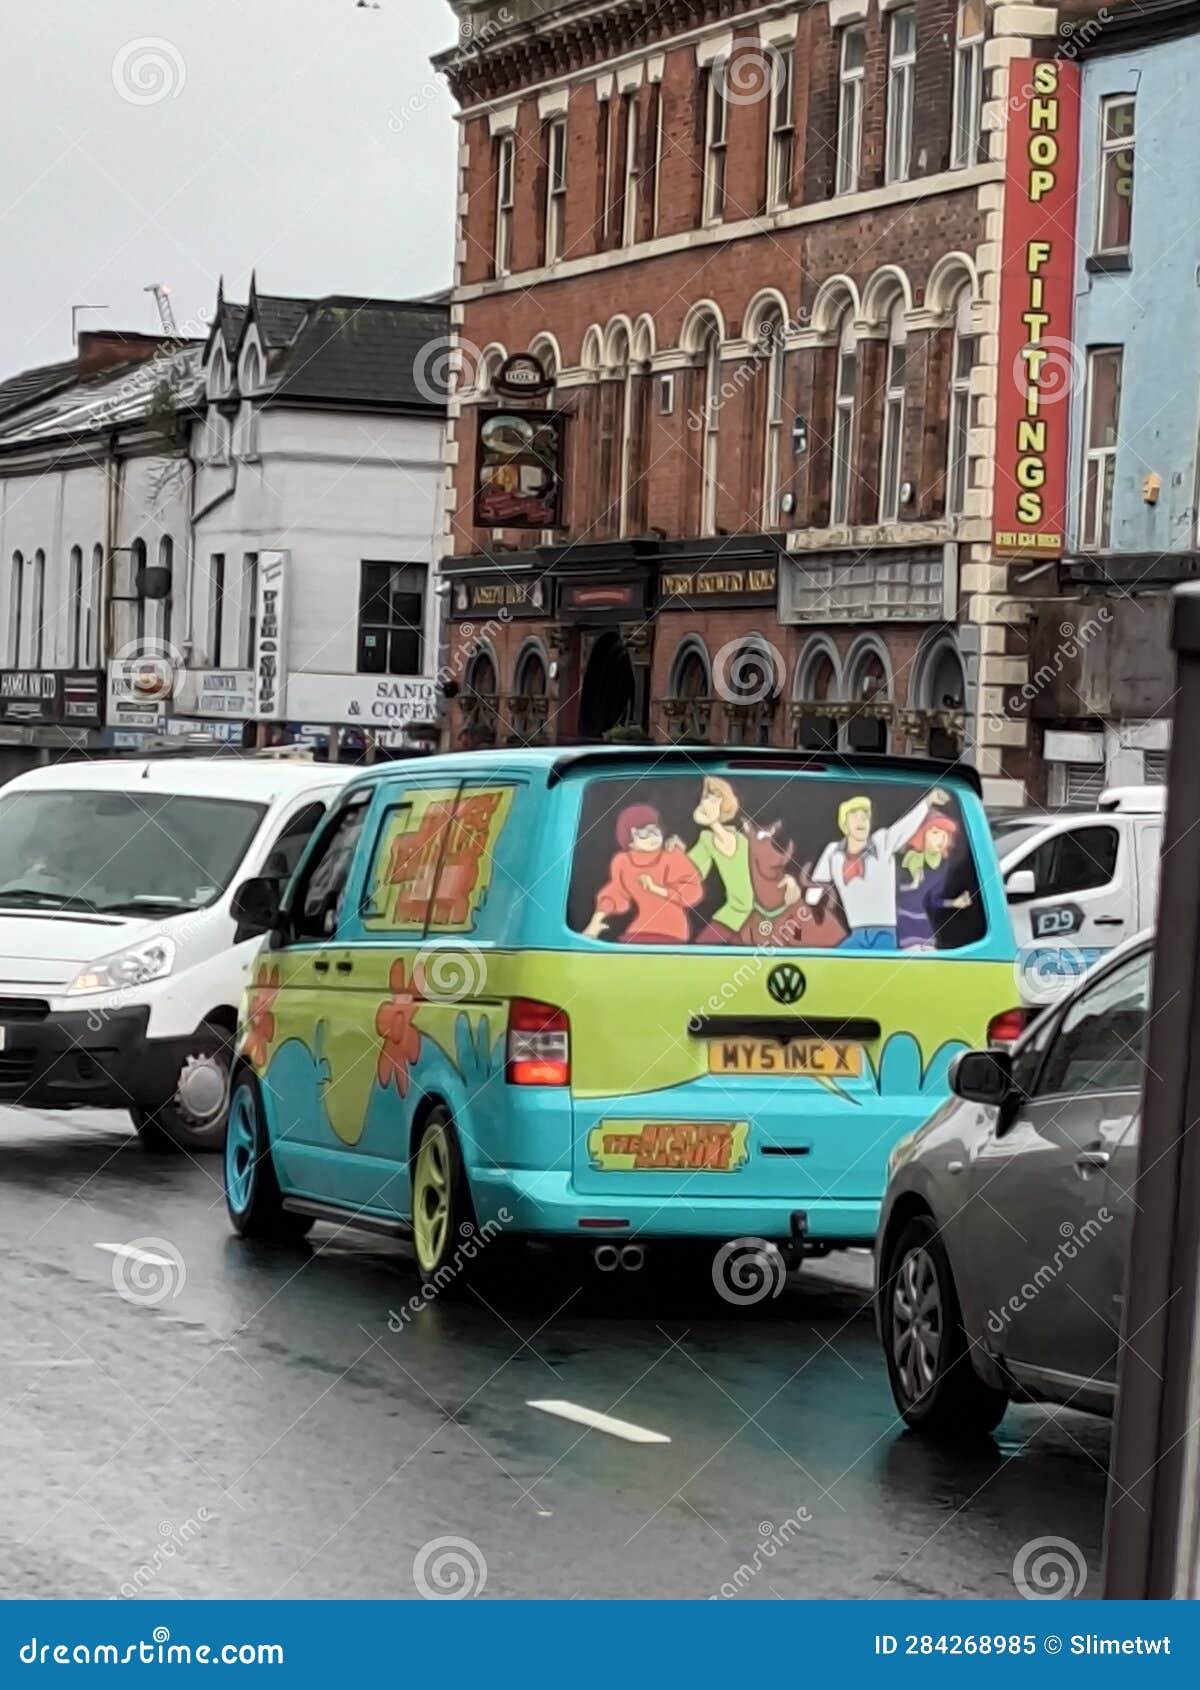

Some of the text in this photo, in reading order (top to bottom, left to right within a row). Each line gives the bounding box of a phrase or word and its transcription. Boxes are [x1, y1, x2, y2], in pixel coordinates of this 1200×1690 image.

[1027, 62, 1058, 202] SHOP
[1016, 240, 1051, 526] FITTINGS
[348, 701, 360, 716] &
